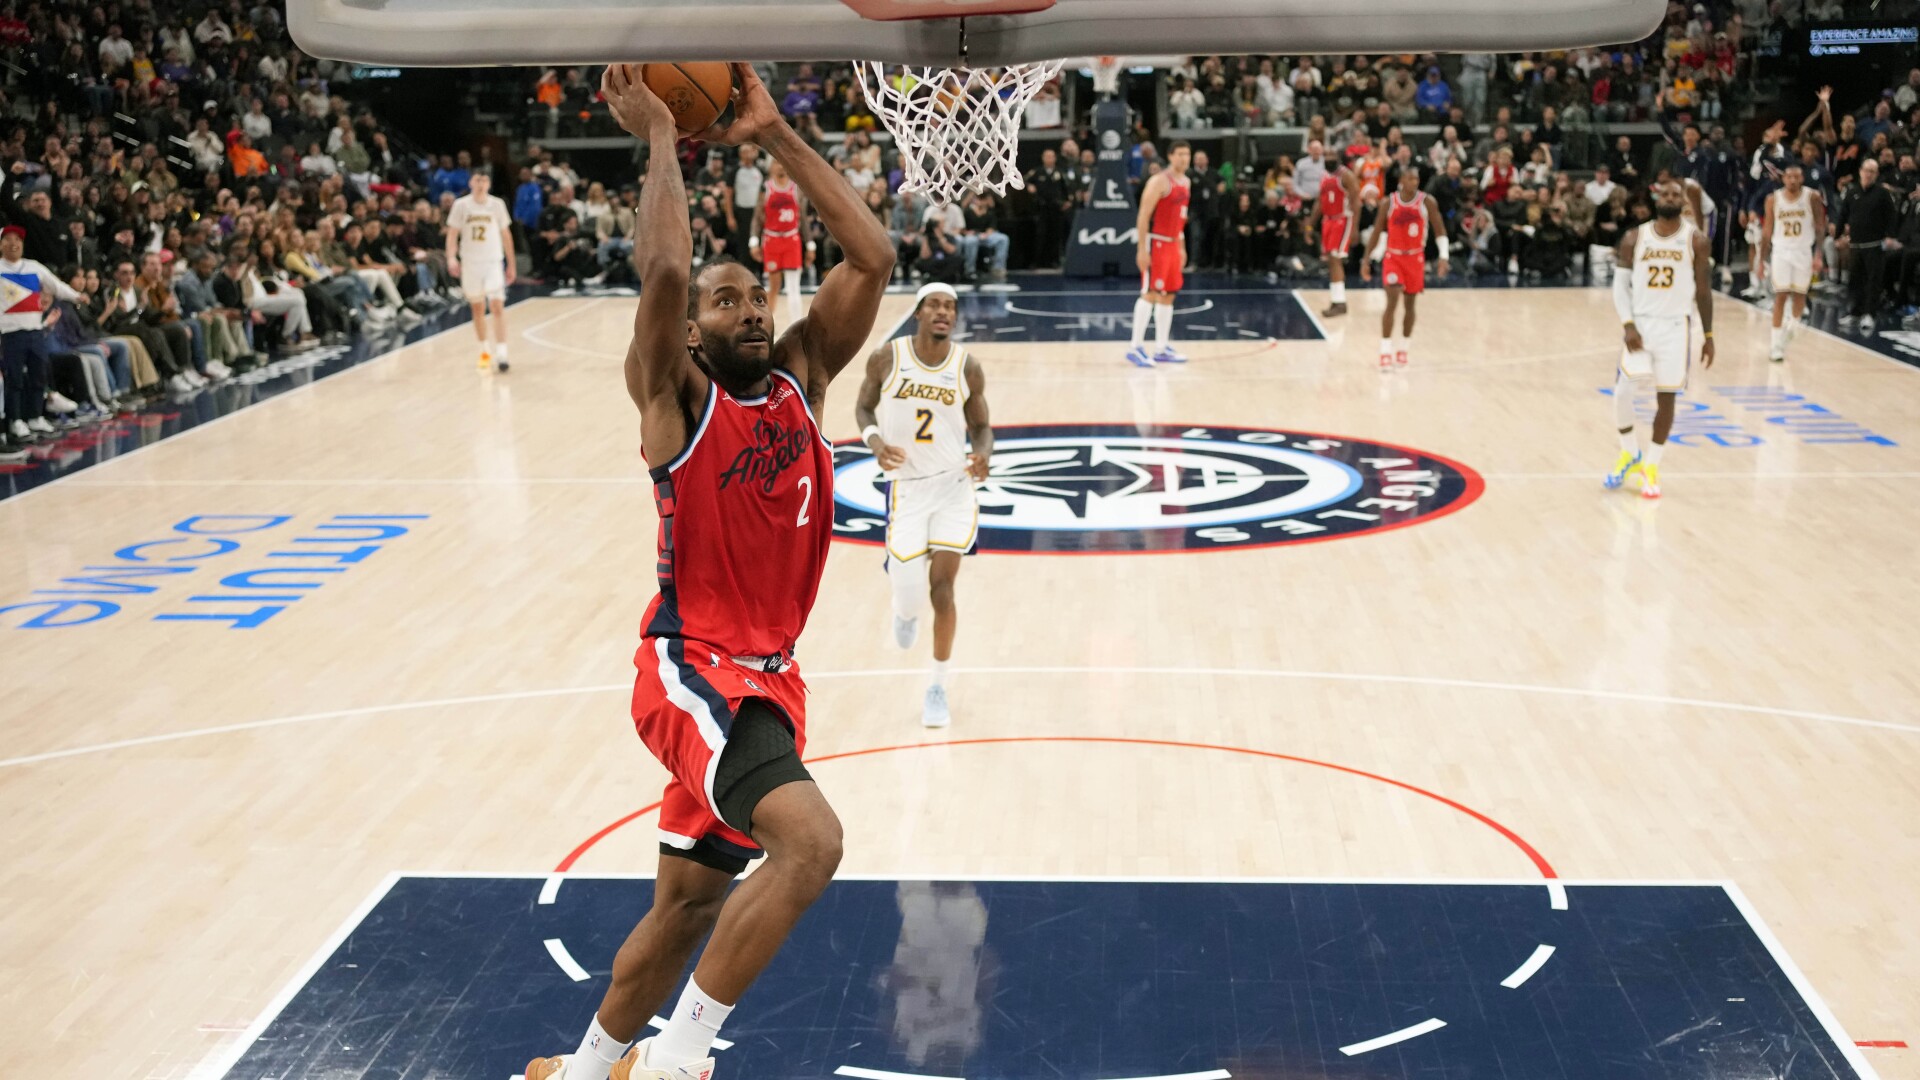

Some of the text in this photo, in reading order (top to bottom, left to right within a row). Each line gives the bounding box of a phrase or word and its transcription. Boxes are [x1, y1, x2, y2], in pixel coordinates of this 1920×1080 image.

[1810, 27, 1918, 41] EXPERIENCE AMAZING
[471, 226, 486, 242] 12
[1783, 221, 1802, 237] 20
[1647, 265, 1674, 289] 23
[770, 386, 785, 404] VISIT
[893, 378, 956, 406] LAKERS
[752, 418, 788, 453] Los
[915, 408, 933, 444] 2
[1181, 428, 1342, 451] LOS
[719, 421, 812, 494] Angeles
[796, 475, 812, 528] 2
